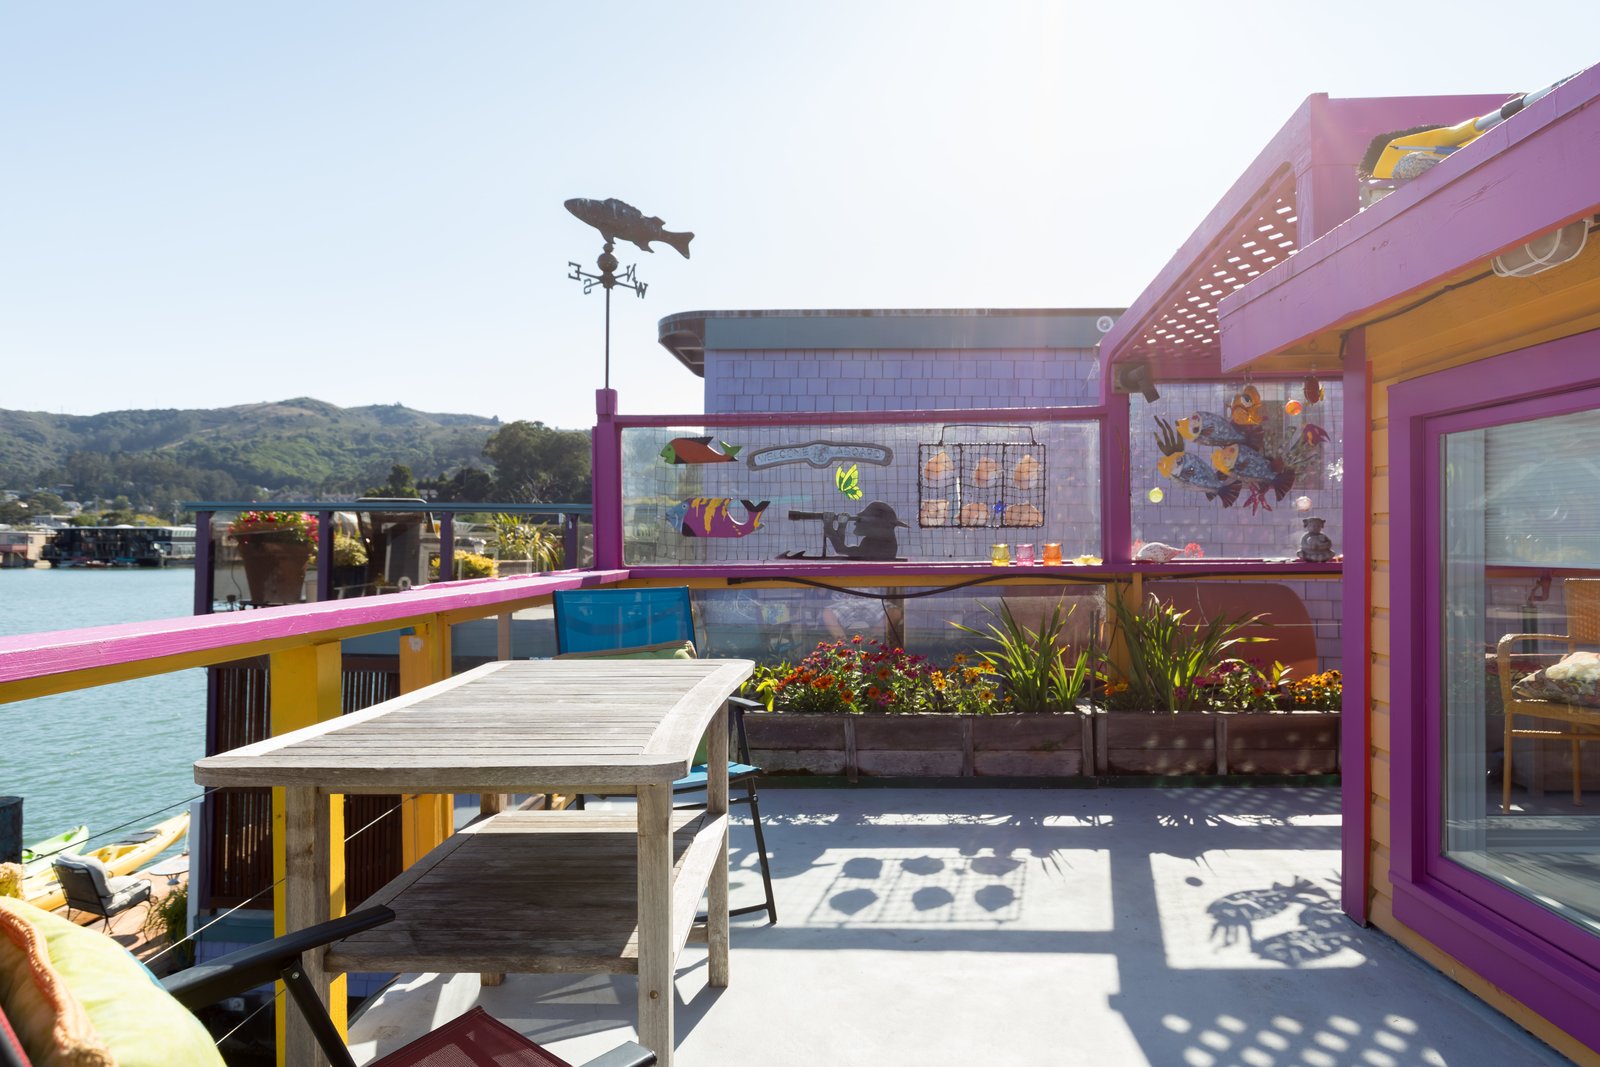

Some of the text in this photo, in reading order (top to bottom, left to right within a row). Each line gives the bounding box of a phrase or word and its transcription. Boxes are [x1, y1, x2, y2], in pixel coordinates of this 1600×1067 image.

[634, 280, 649, 299] W
[757, 446, 882, 463] WELCOME ABOARD
